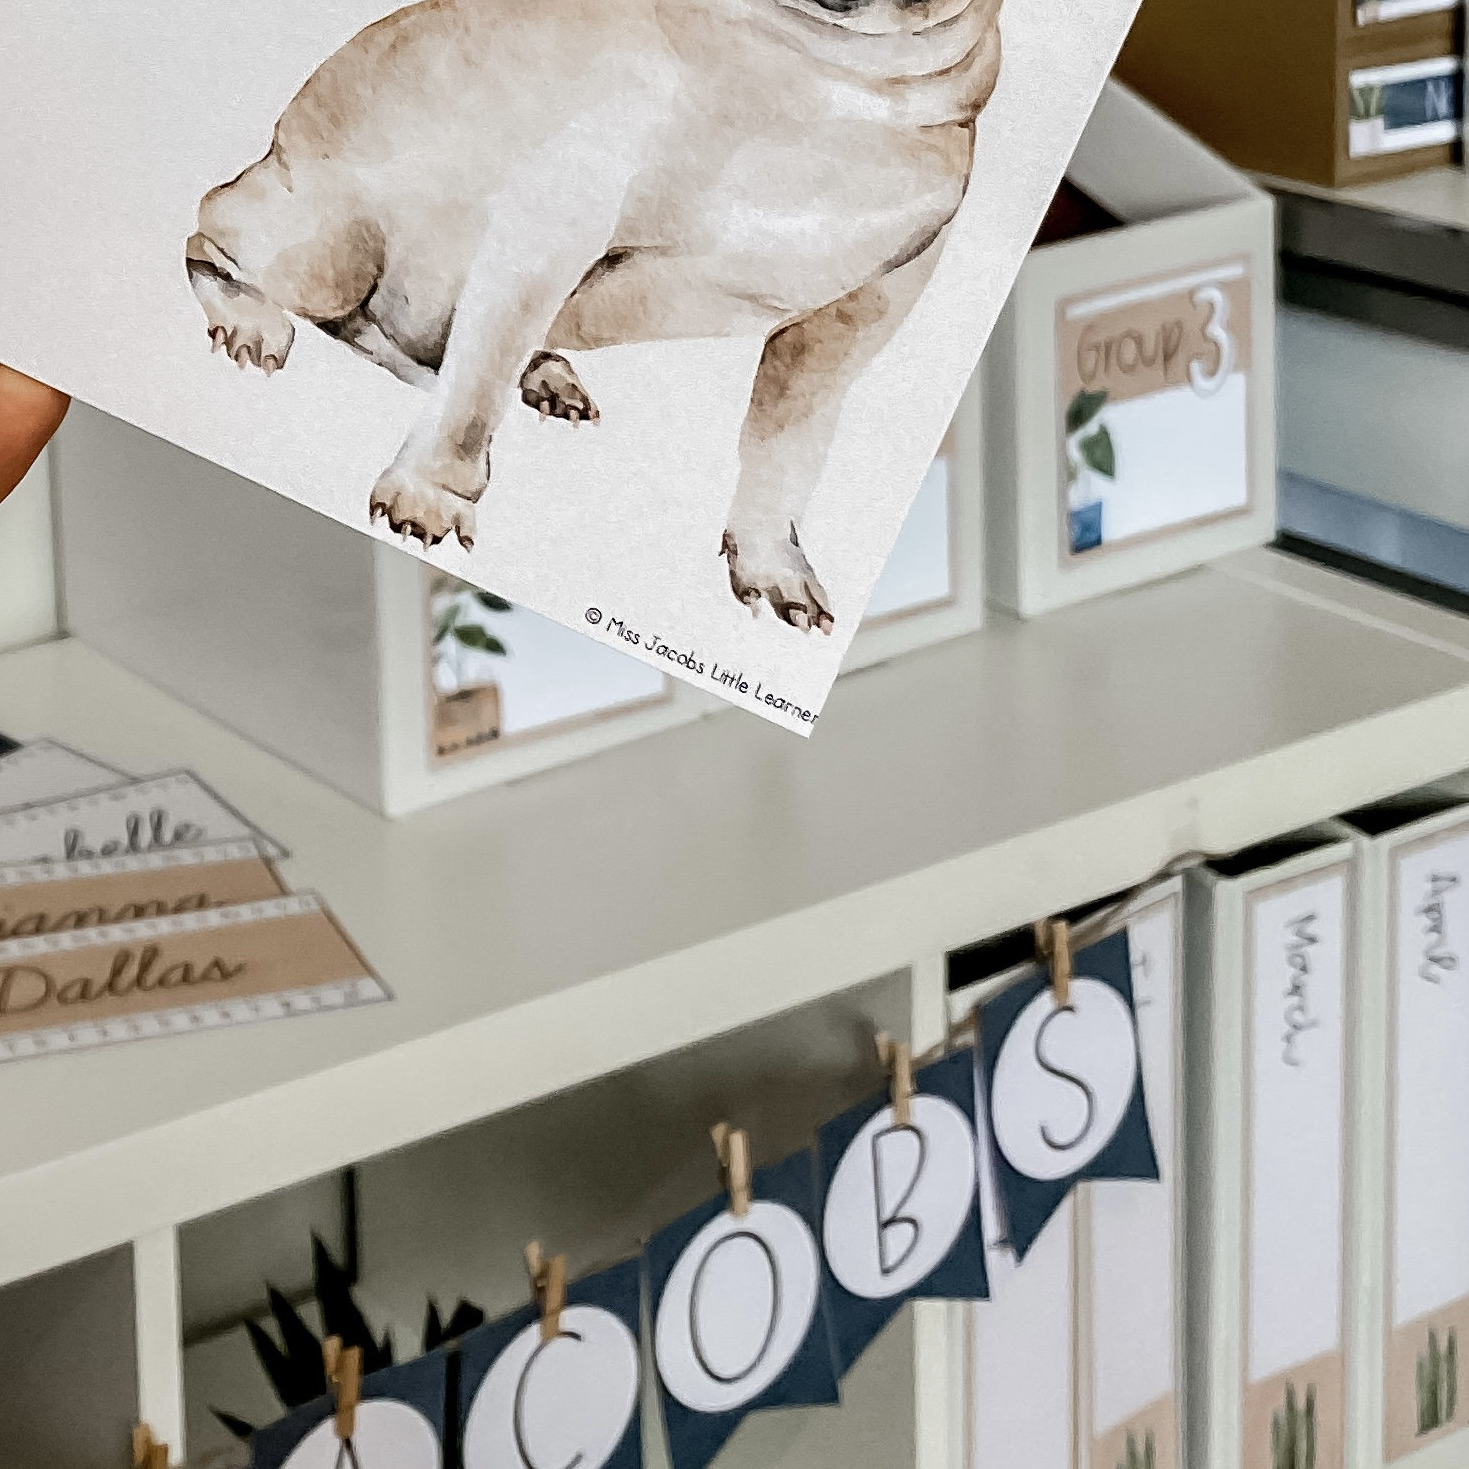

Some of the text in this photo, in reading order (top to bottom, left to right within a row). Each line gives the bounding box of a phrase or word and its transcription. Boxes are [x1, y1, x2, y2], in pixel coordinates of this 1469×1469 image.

[1076, 286, 1229, 398] Group 3
[606, 617, 641, 645] Miss
[644, 634, 705, 675] Jacobs
[710, 662, 749, 693] Little
